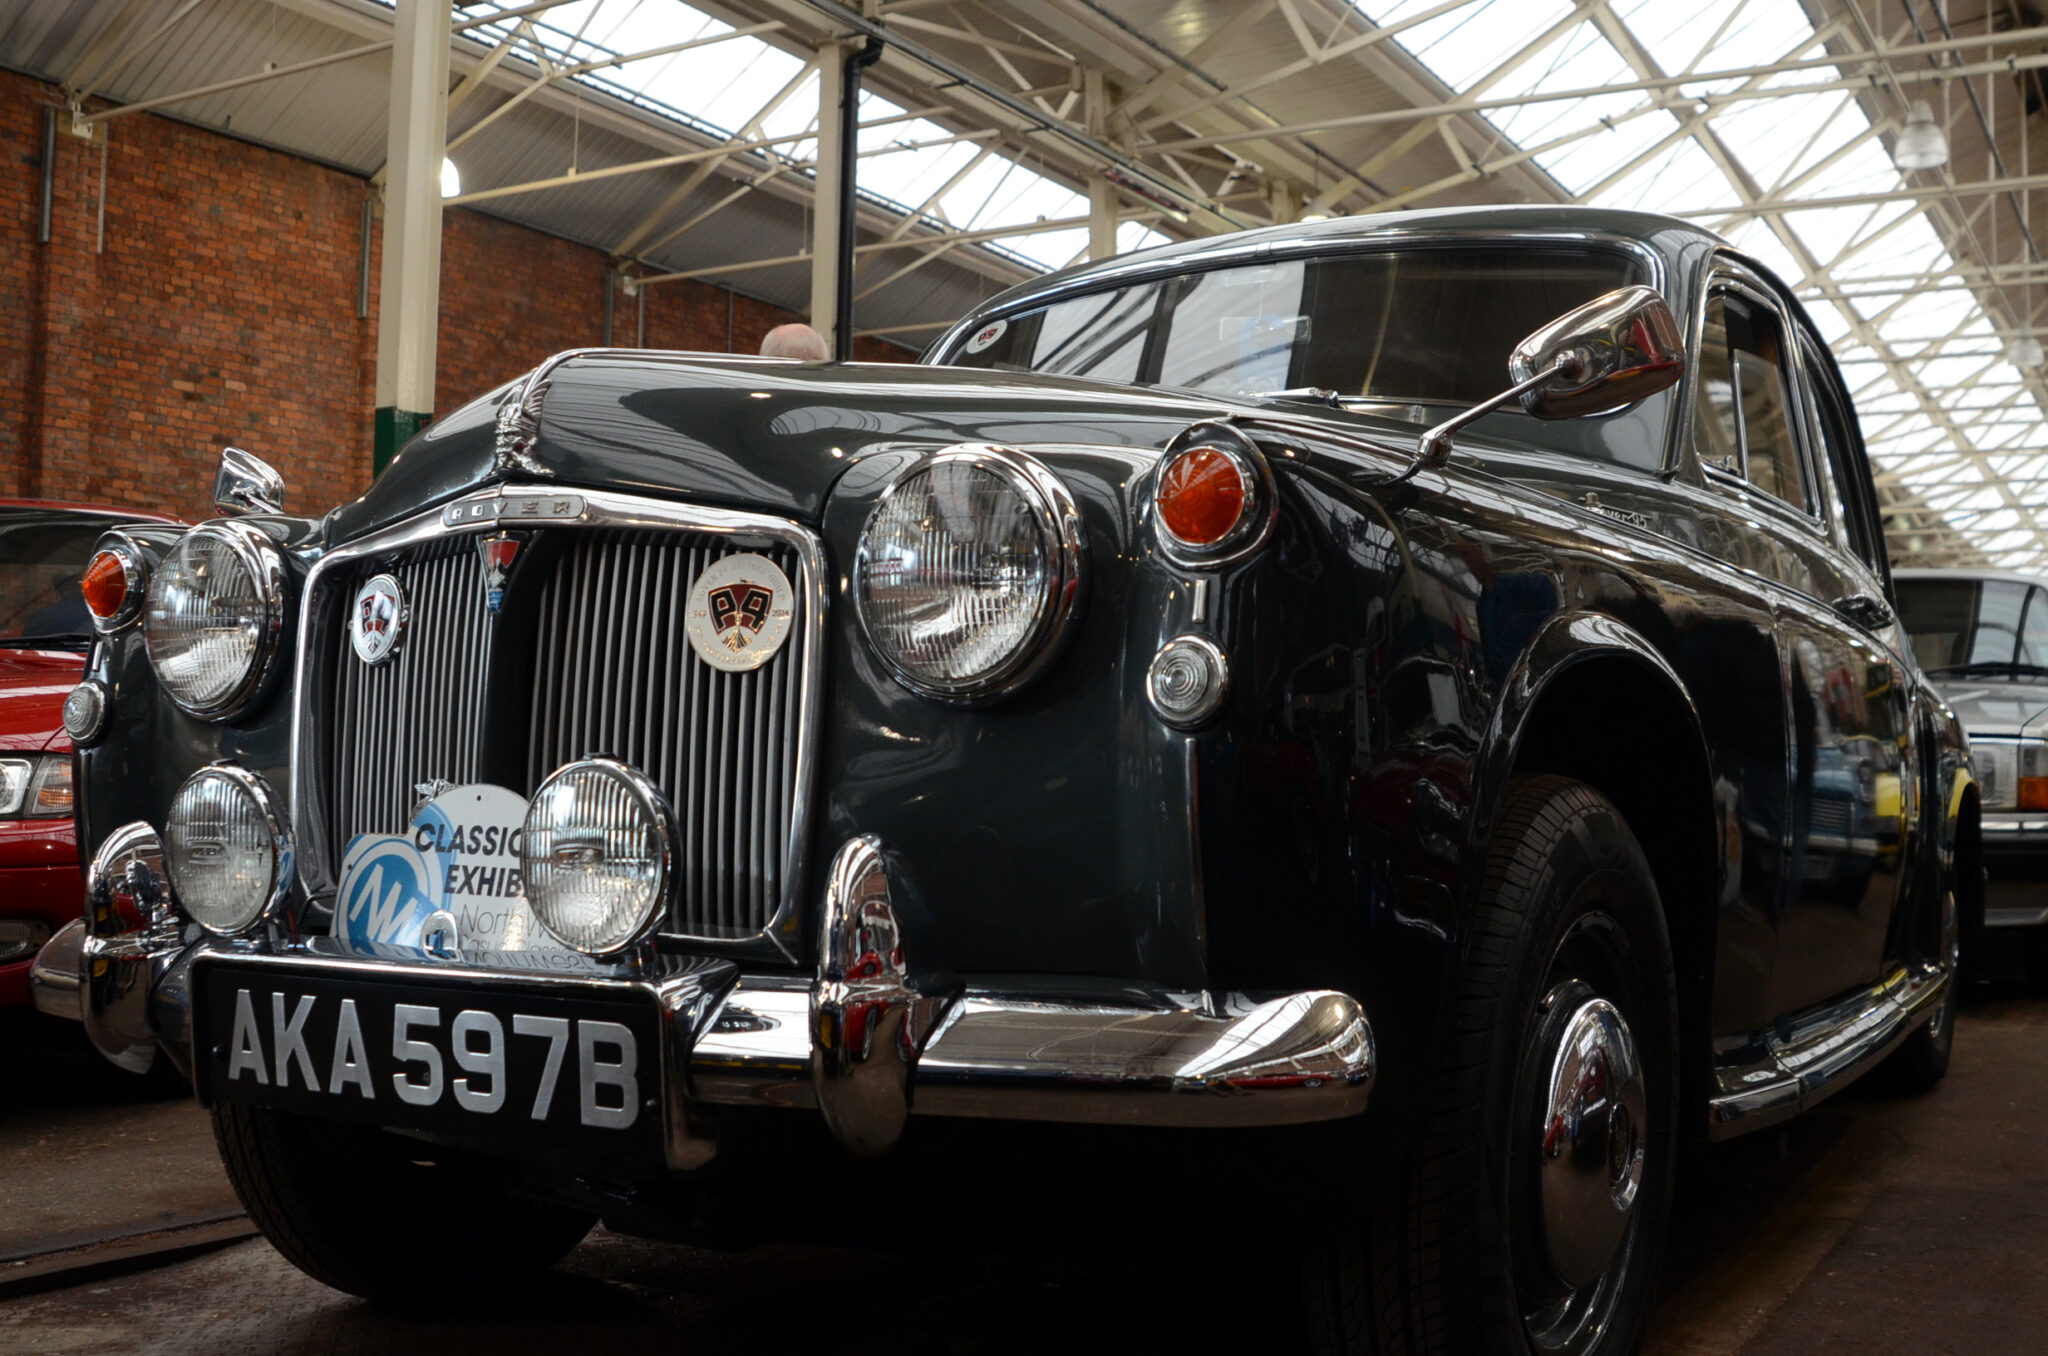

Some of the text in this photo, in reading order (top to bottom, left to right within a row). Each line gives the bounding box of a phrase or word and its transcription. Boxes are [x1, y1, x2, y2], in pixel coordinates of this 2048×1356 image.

[451, 501, 569, 520] ROVER
[228, 988, 640, 1131] AKA 597B
